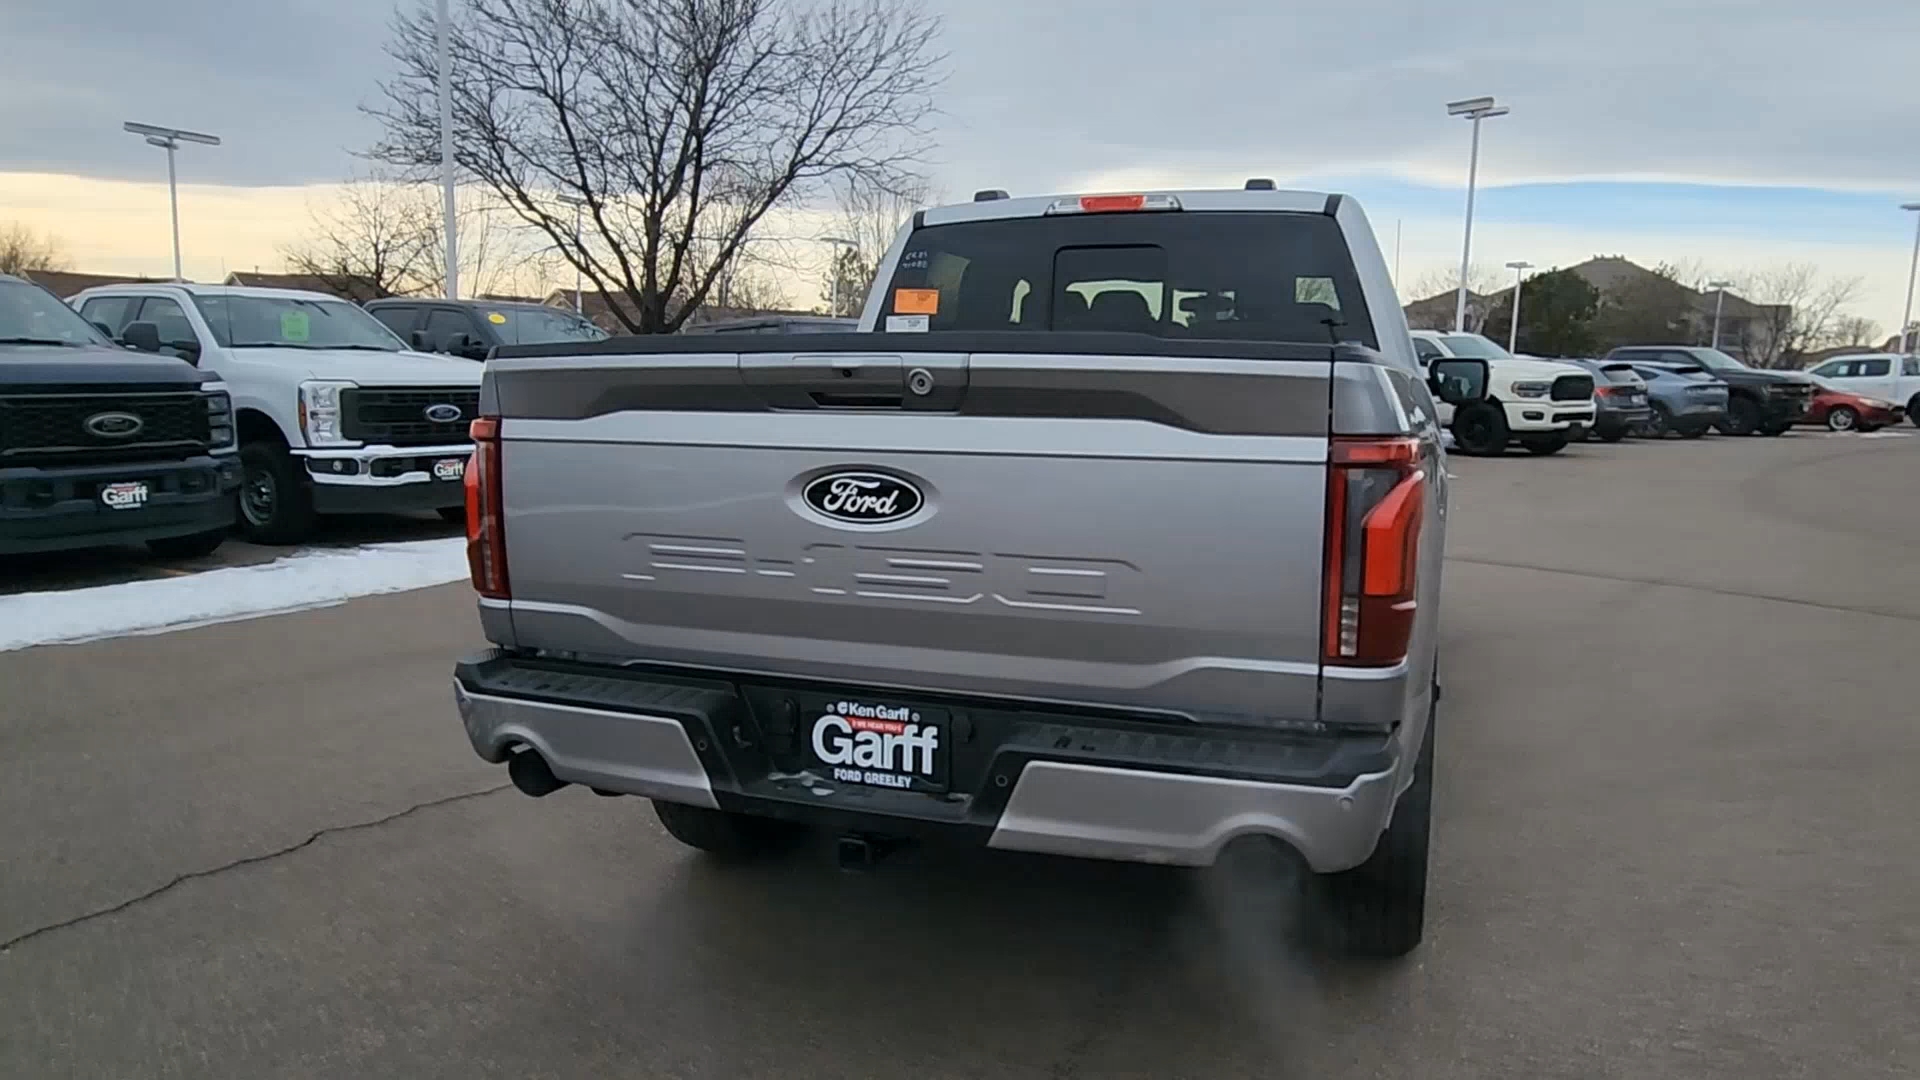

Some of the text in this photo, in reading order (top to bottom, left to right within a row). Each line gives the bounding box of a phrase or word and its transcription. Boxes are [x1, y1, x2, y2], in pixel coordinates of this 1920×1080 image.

[434, 463, 463, 476] Garff
[102, 486, 148, 504] Garff
[823, 478, 899, 514] Ford
[622, 532, 1142, 615] F-150
[849, 702, 909, 721] Ken Garff
[812, 714, 938, 775] Garff
[834, 768, 912, 788] FORD GREELEY
